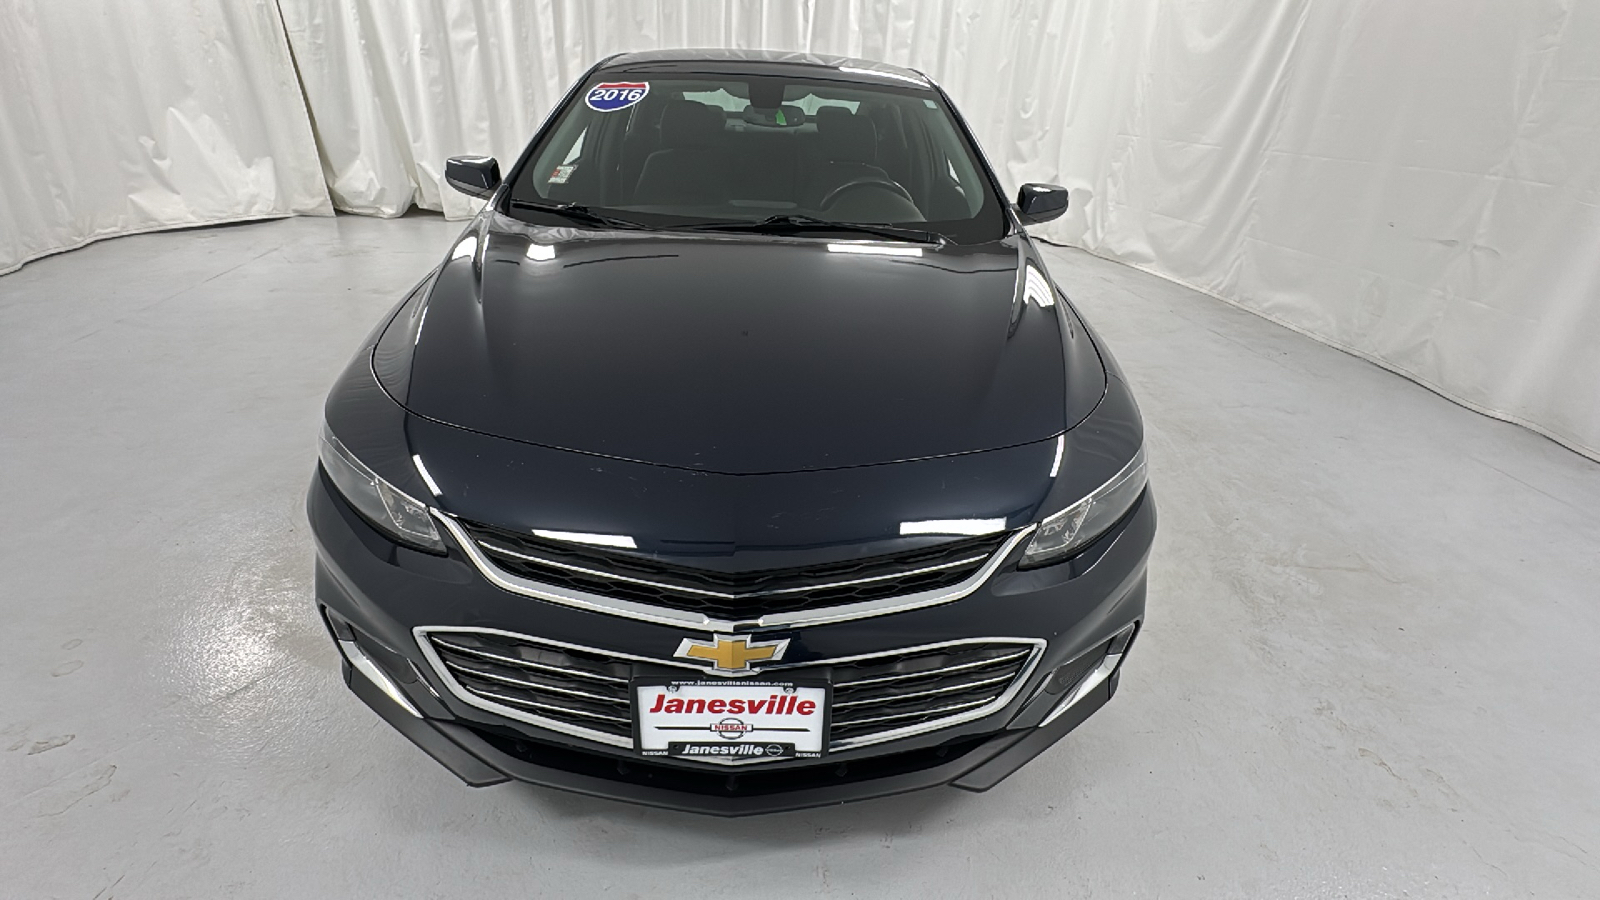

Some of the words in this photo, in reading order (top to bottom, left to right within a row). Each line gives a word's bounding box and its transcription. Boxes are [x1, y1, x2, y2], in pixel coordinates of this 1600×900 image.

[589, 89, 642, 101] 2016
[650, 694, 816, 715] Janesville
[682, 744, 764, 755] Janesville
